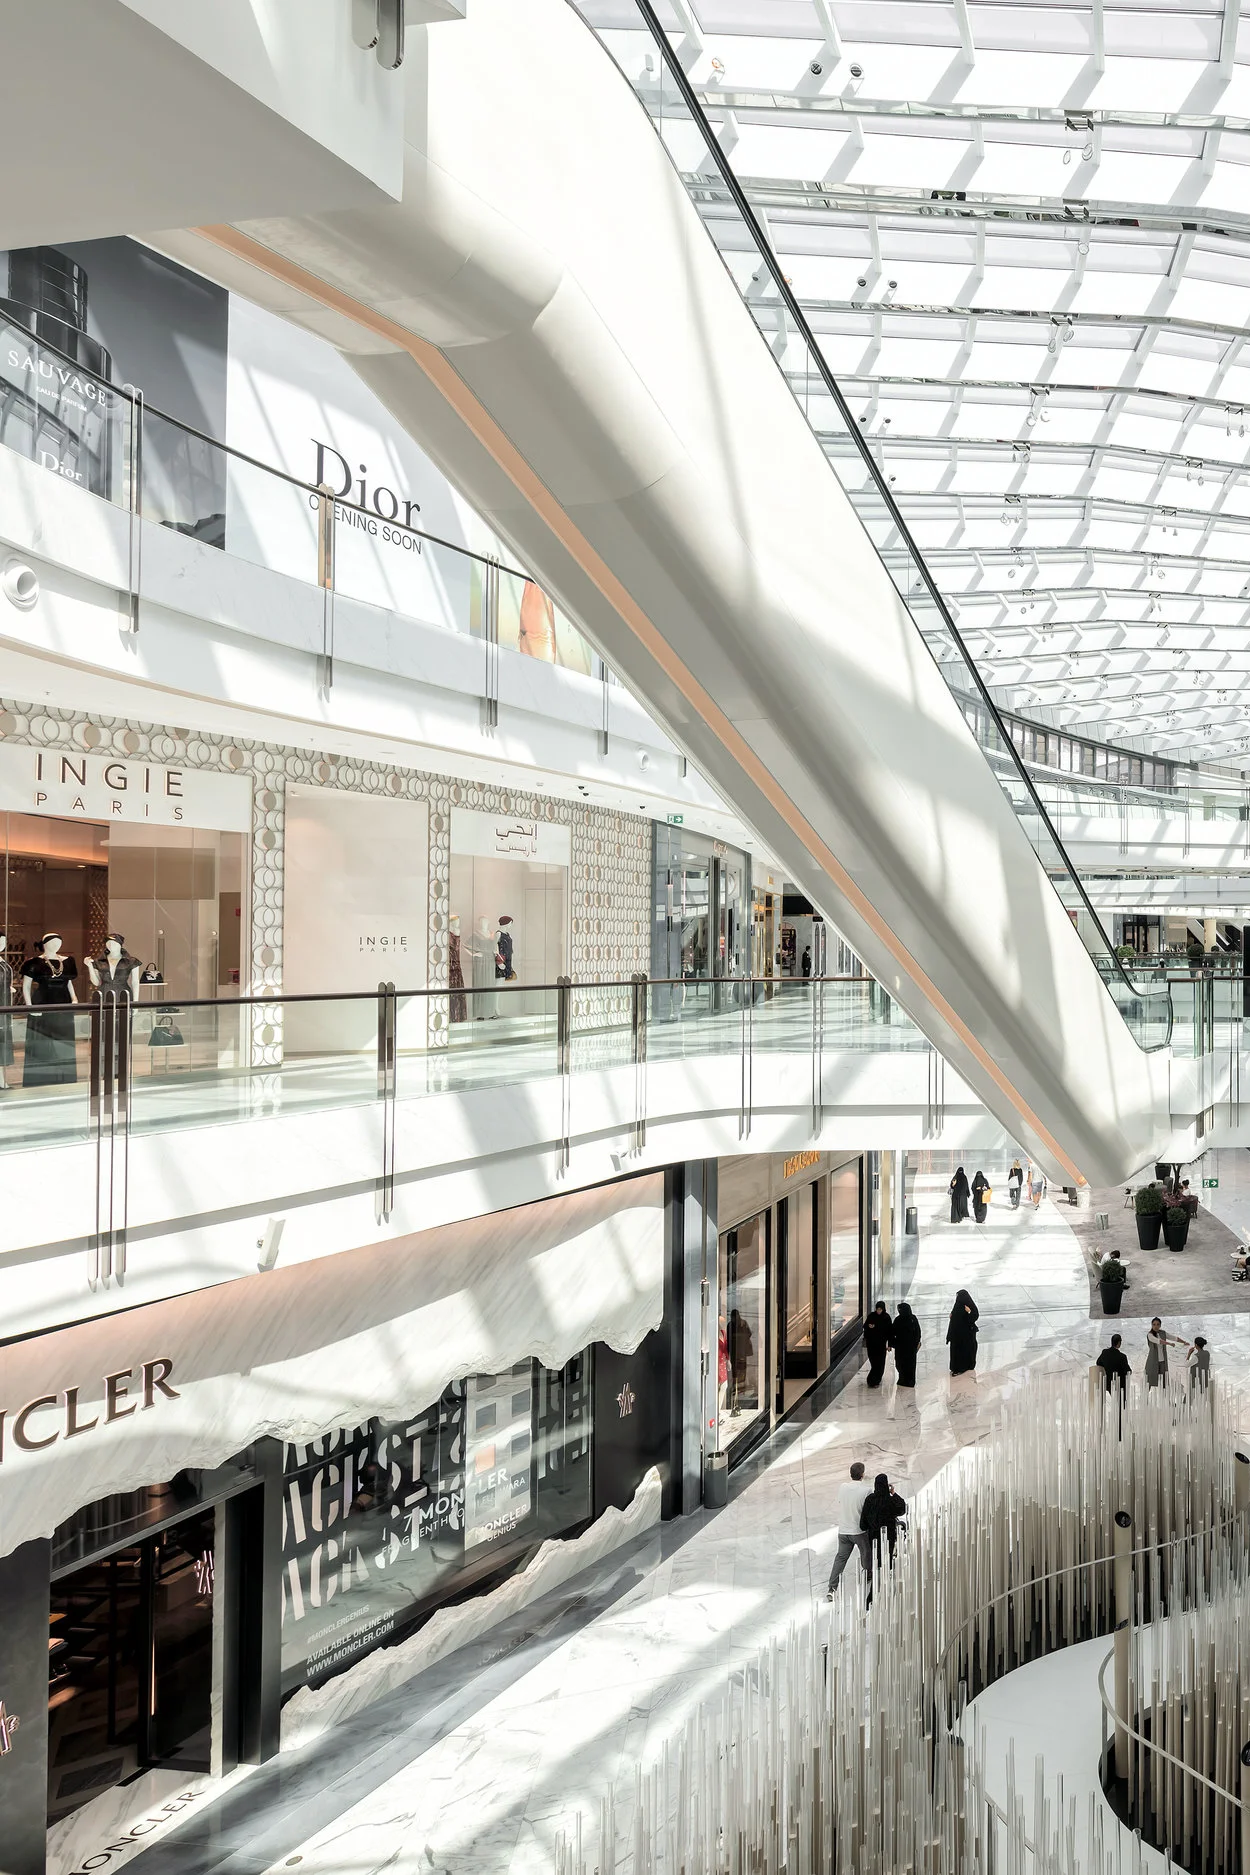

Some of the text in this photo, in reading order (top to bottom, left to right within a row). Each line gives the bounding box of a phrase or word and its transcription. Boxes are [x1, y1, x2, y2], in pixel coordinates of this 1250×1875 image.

[8, 350, 107, 407] SAUVAGE
[40, 450, 83, 482] Dior
[308, 438, 421, 527] Dior
[308, 494, 422, 555] OENING SOON
[34, 753, 184, 797] INGIE
[35, 792, 183, 820] PARIS
[359, 936, 408, 946] INGIE
[0, 1357, 182, 1466] CLER
[475, 1504, 528, 1540] MONCLER
[306, 1608, 395, 1665] AVAILABLE ONLINE ON
[306, 1620, 395, 1678] WWW.MONCLER.COM
[68, 1790, 206, 1875] ONCLER
